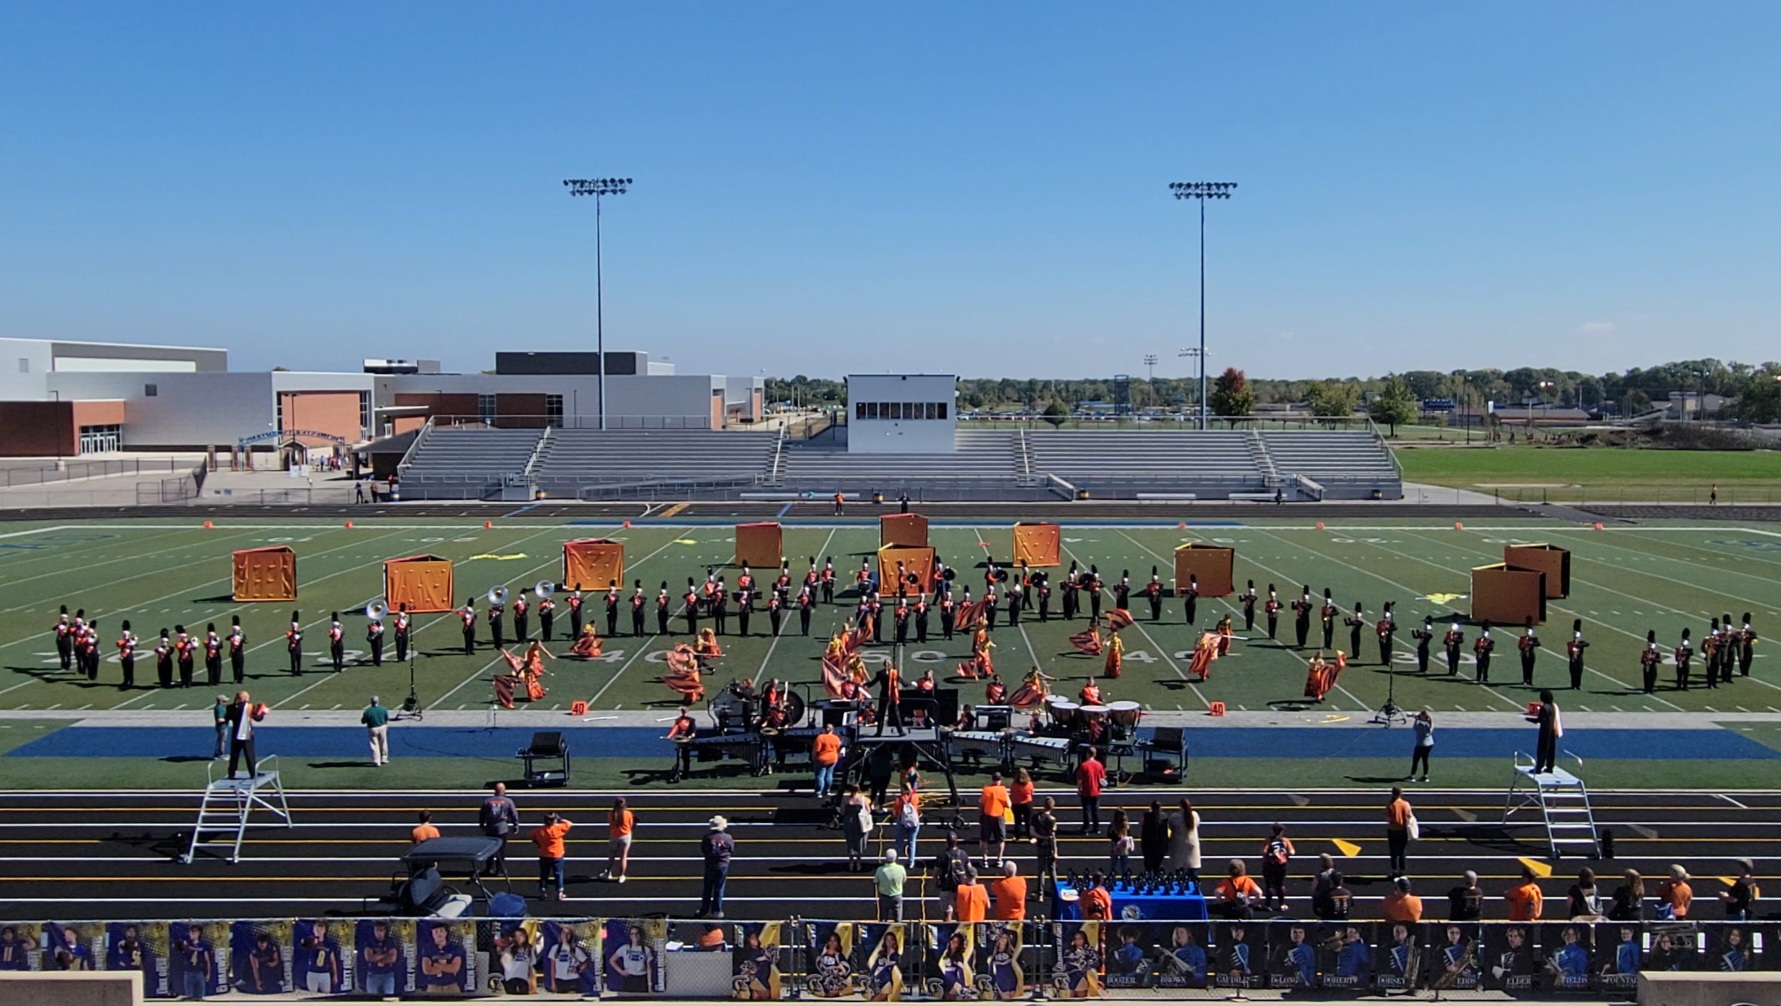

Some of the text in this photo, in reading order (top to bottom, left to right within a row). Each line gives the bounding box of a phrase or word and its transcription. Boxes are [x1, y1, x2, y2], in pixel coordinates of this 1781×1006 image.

[572, 703, 585, 715] 40
[1211, 703, 1224, 715] 40
[1107, 976, 1137, 984] BOOZER
[1323, 976, 1358, 984] DOHERTY
[1377, 976, 1406, 984] DORSEY
[1506, 977, 1531, 985] ELDER
